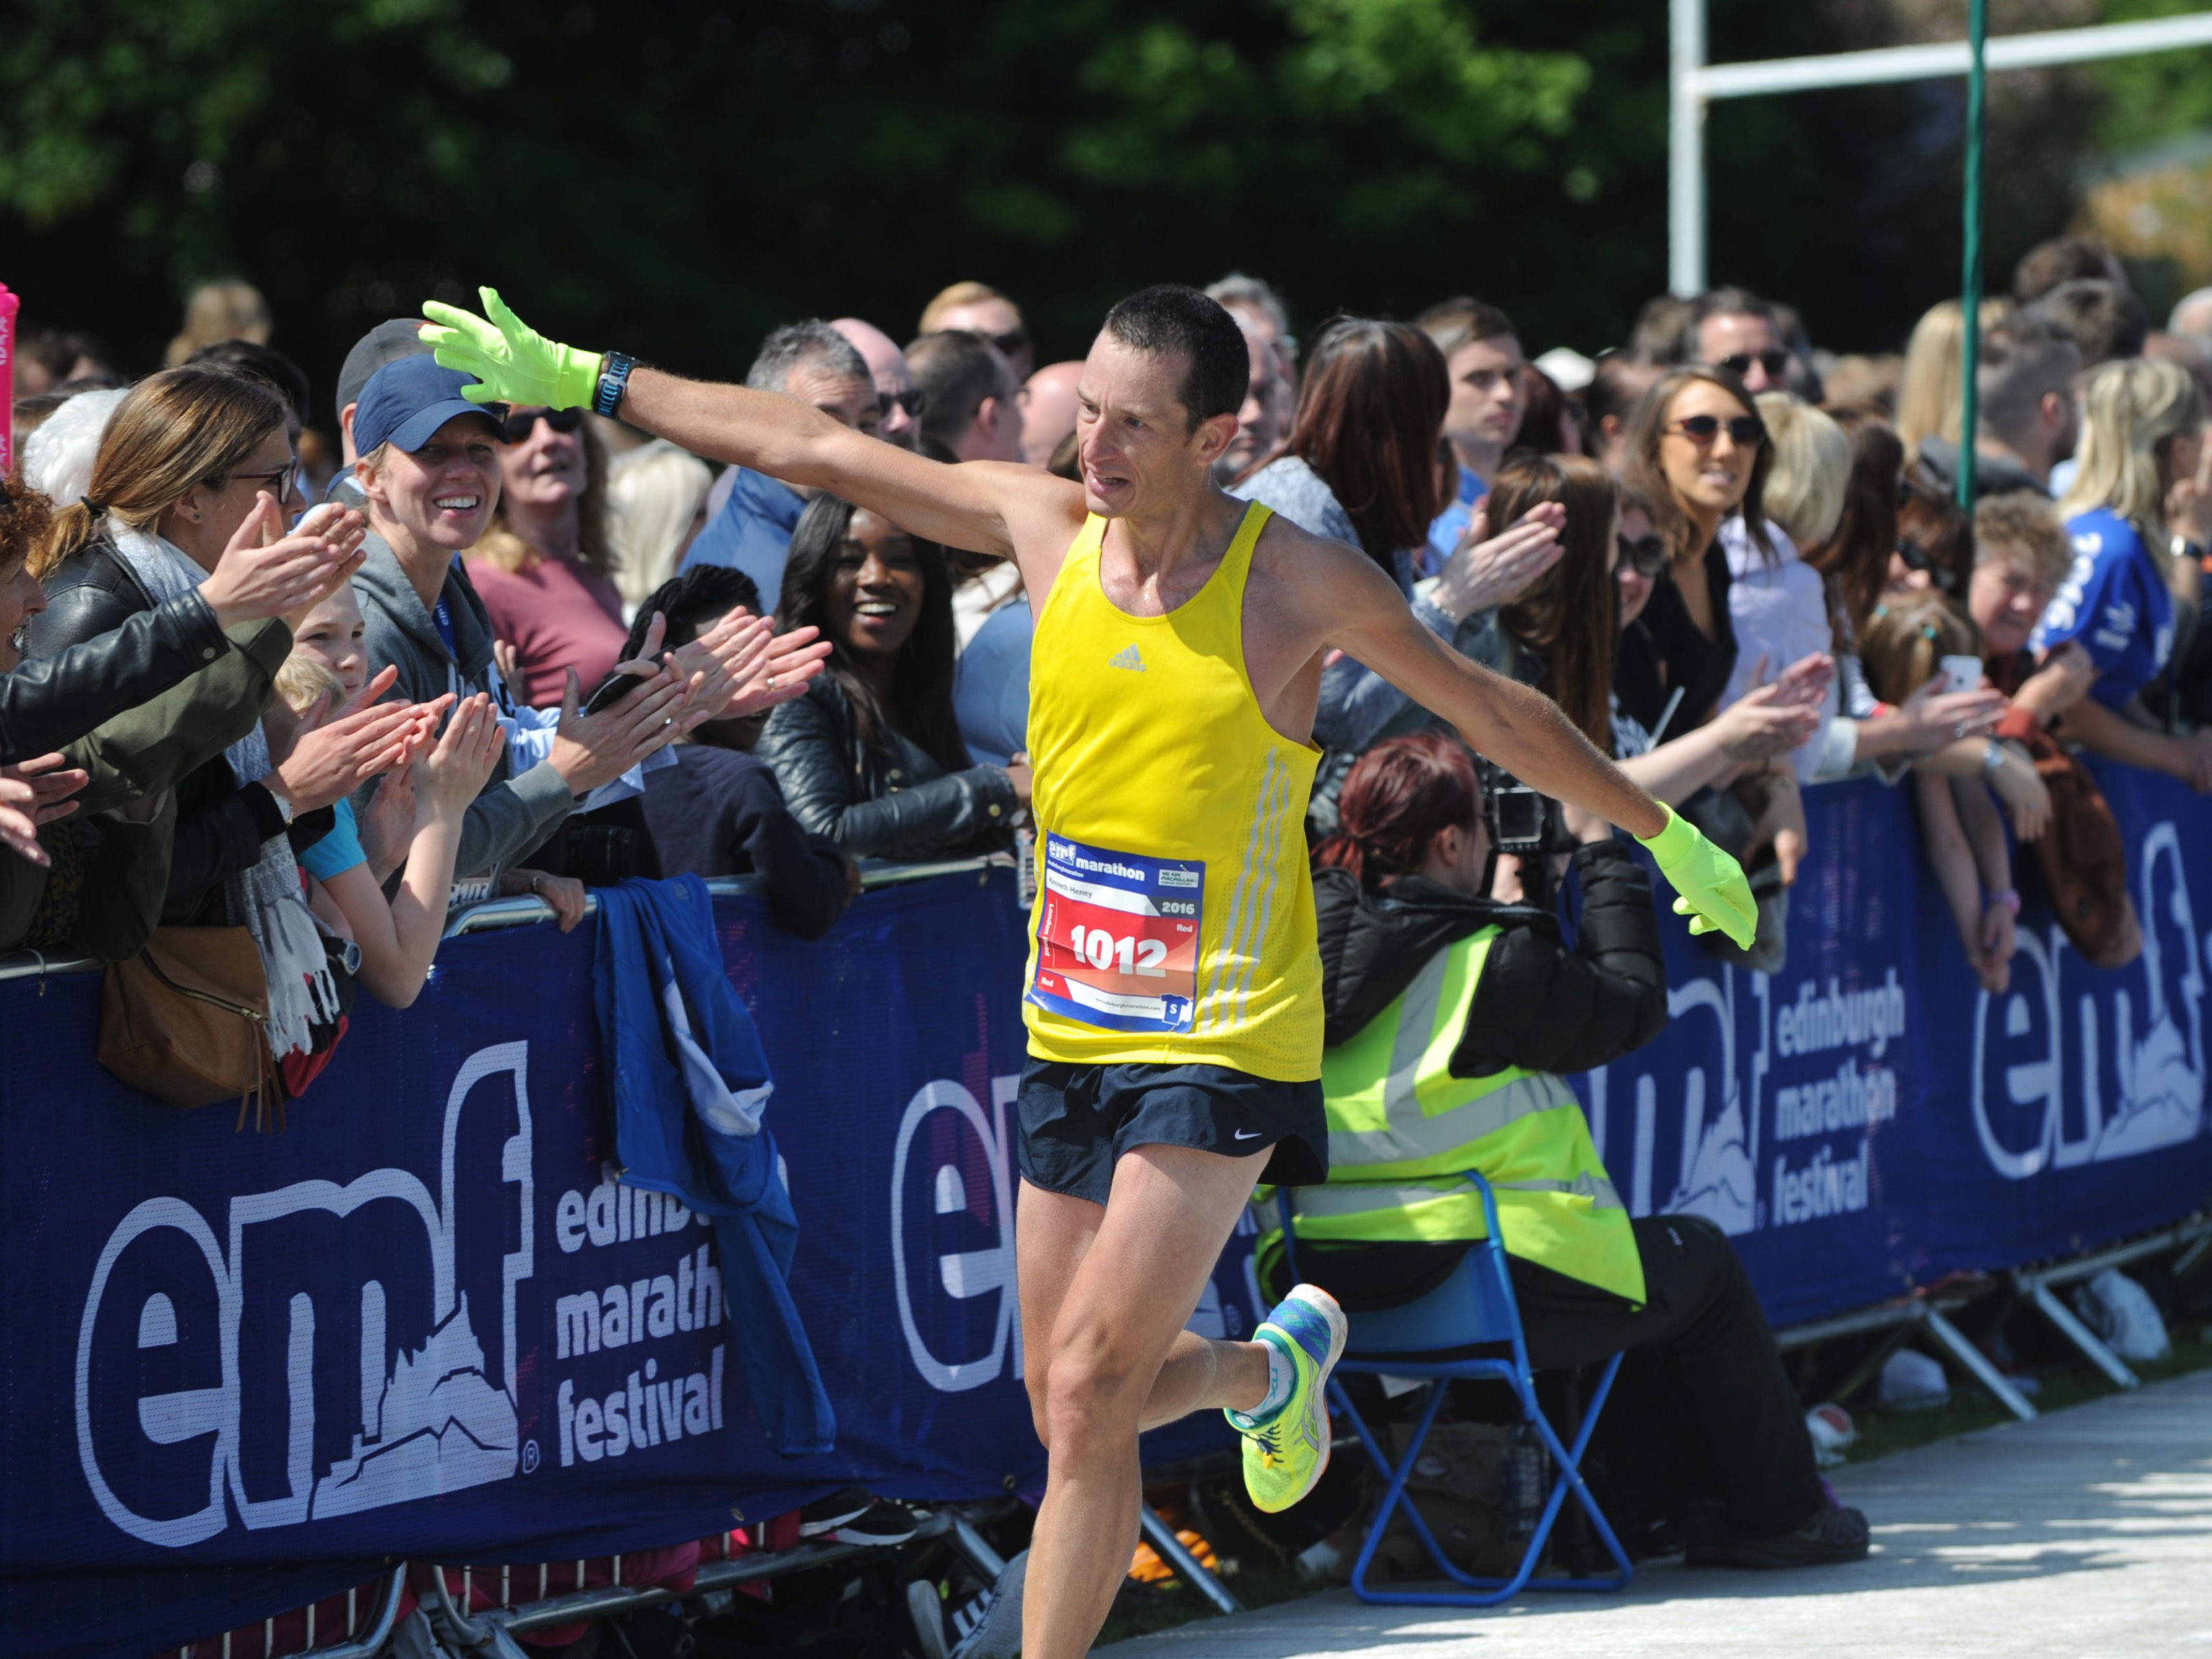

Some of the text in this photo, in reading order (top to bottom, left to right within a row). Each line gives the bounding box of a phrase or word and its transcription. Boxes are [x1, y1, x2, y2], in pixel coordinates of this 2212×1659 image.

[1109, 658, 1146, 672] adidas
[1049, 841, 1145, 882] emf marathon
[1049, 876, 1092, 899] Kenneth Heney
[1044, 903, 1055, 935] London
[1161, 902, 1195, 915] 2016
[1176, 924, 1193, 932] Red
[1071, 924, 1167, 978] 1012
[1041, 977, 1054, 987] Red
[1169, 1004, 1178, 1014] S
[1973, 821, 2205, 1180] emf
[1776, 967, 1905, 1058] edinburgh
[1776, 1056, 1896, 1141] marathon
[556, 1161, 714, 1253] edinb
[1773, 1139, 1869, 1227] festival
[75, 1040, 533, 1547] emf
[556, 1243, 729, 1360] marath
[558, 1343, 725, 1467] festival
